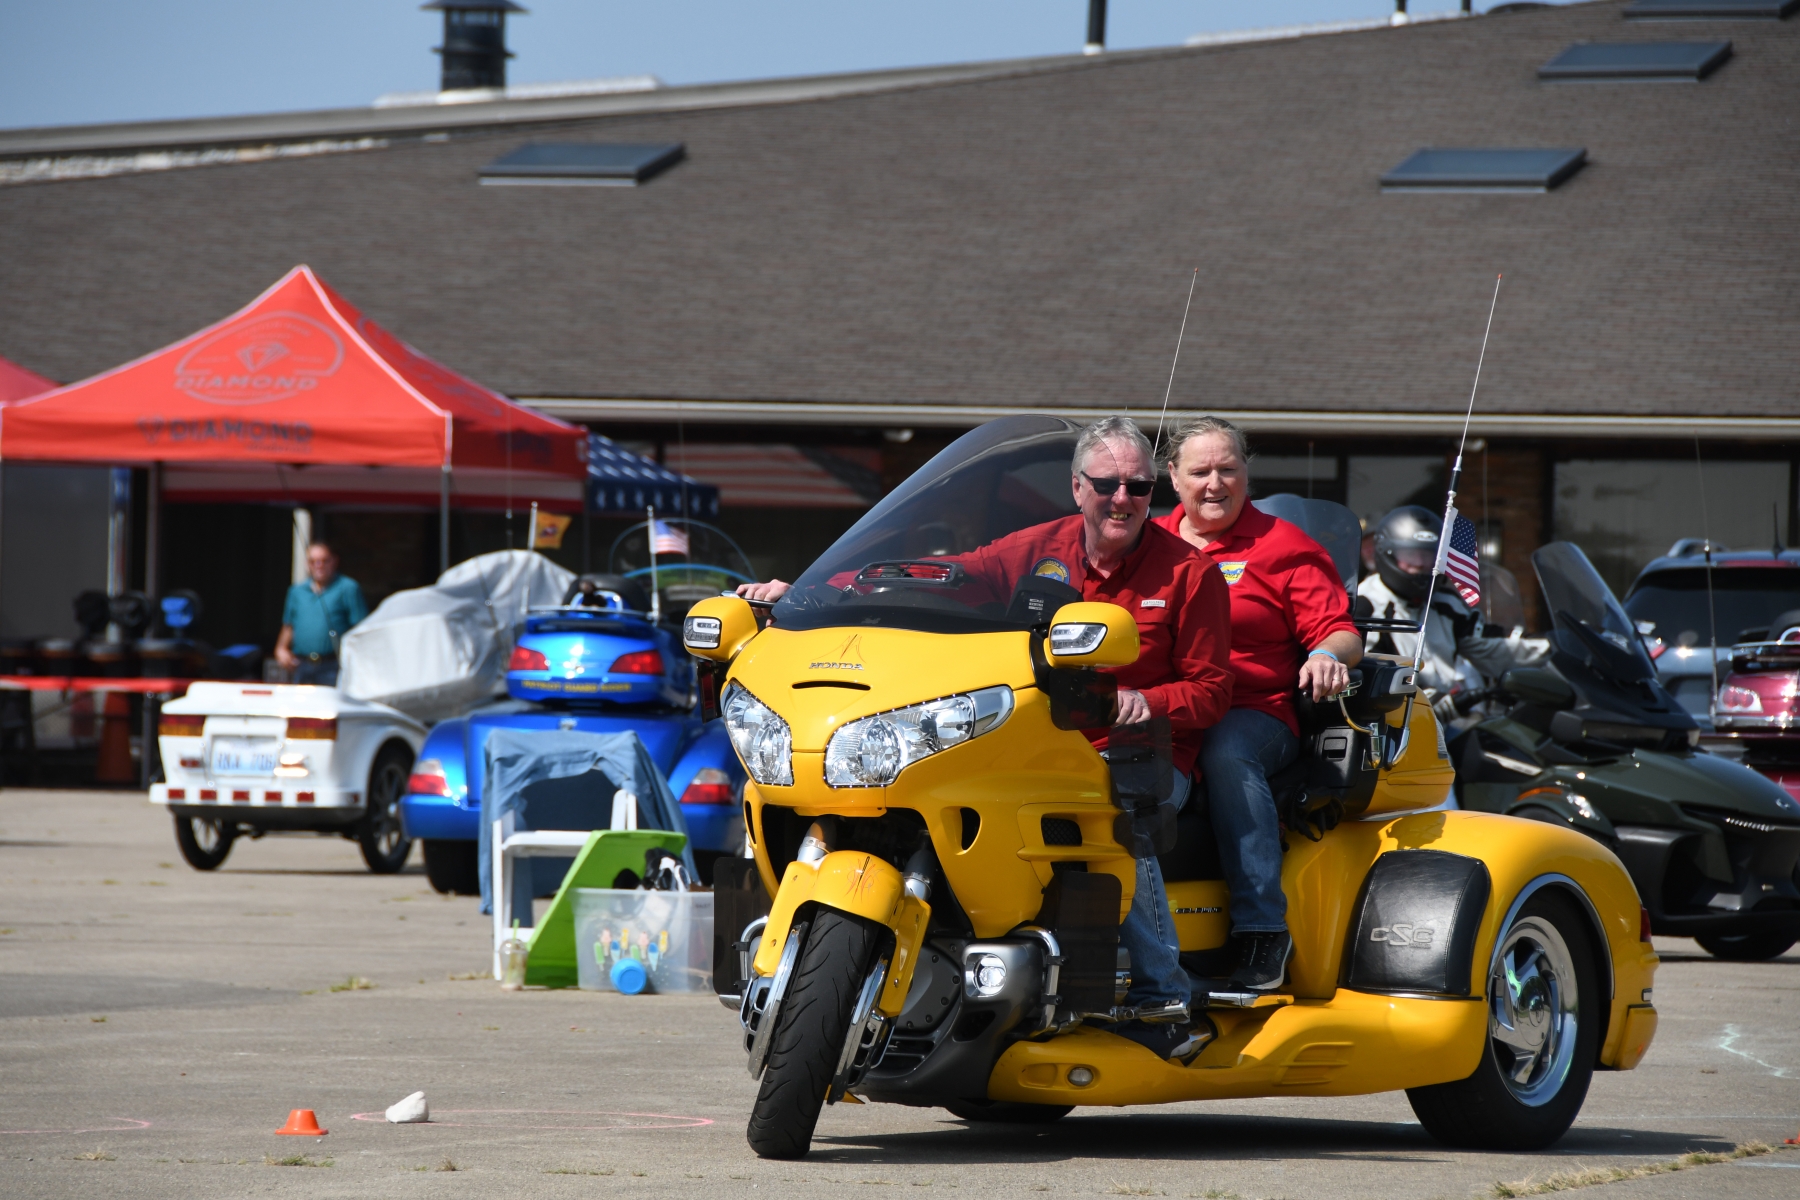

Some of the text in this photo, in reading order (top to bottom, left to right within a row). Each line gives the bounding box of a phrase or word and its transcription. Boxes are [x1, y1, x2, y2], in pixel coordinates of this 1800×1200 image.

[174, 374, 318, 390] DIAMOND
[170, 418, 313, 442] DIAMOND
[808, 661, 864, 671] HONDA
